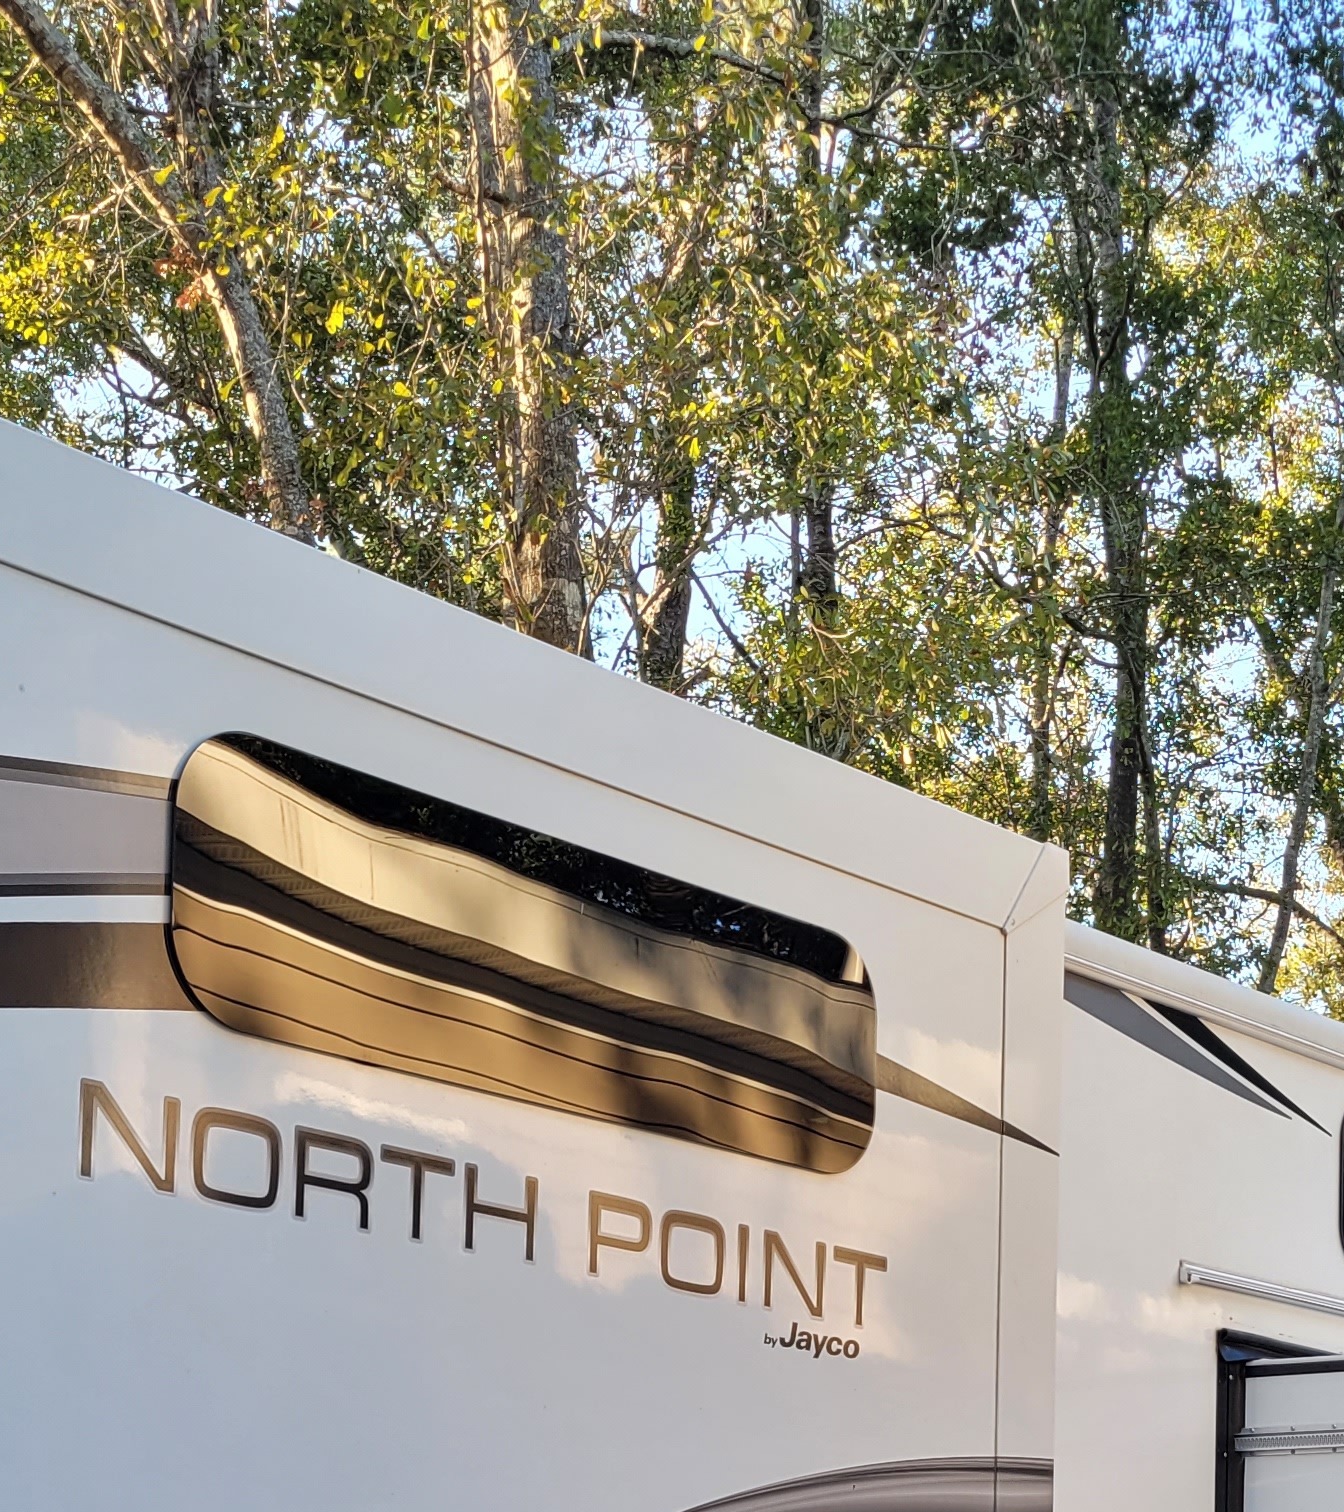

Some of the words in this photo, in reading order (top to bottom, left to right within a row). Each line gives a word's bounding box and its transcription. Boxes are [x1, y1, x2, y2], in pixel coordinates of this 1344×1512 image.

[79, 1077, 539, 1263] NORTH
[588, 1189, 888, 1327] POINT
[763, 1332, 778, 1348] by
[779, 1321, 860, 1359] Jayco
